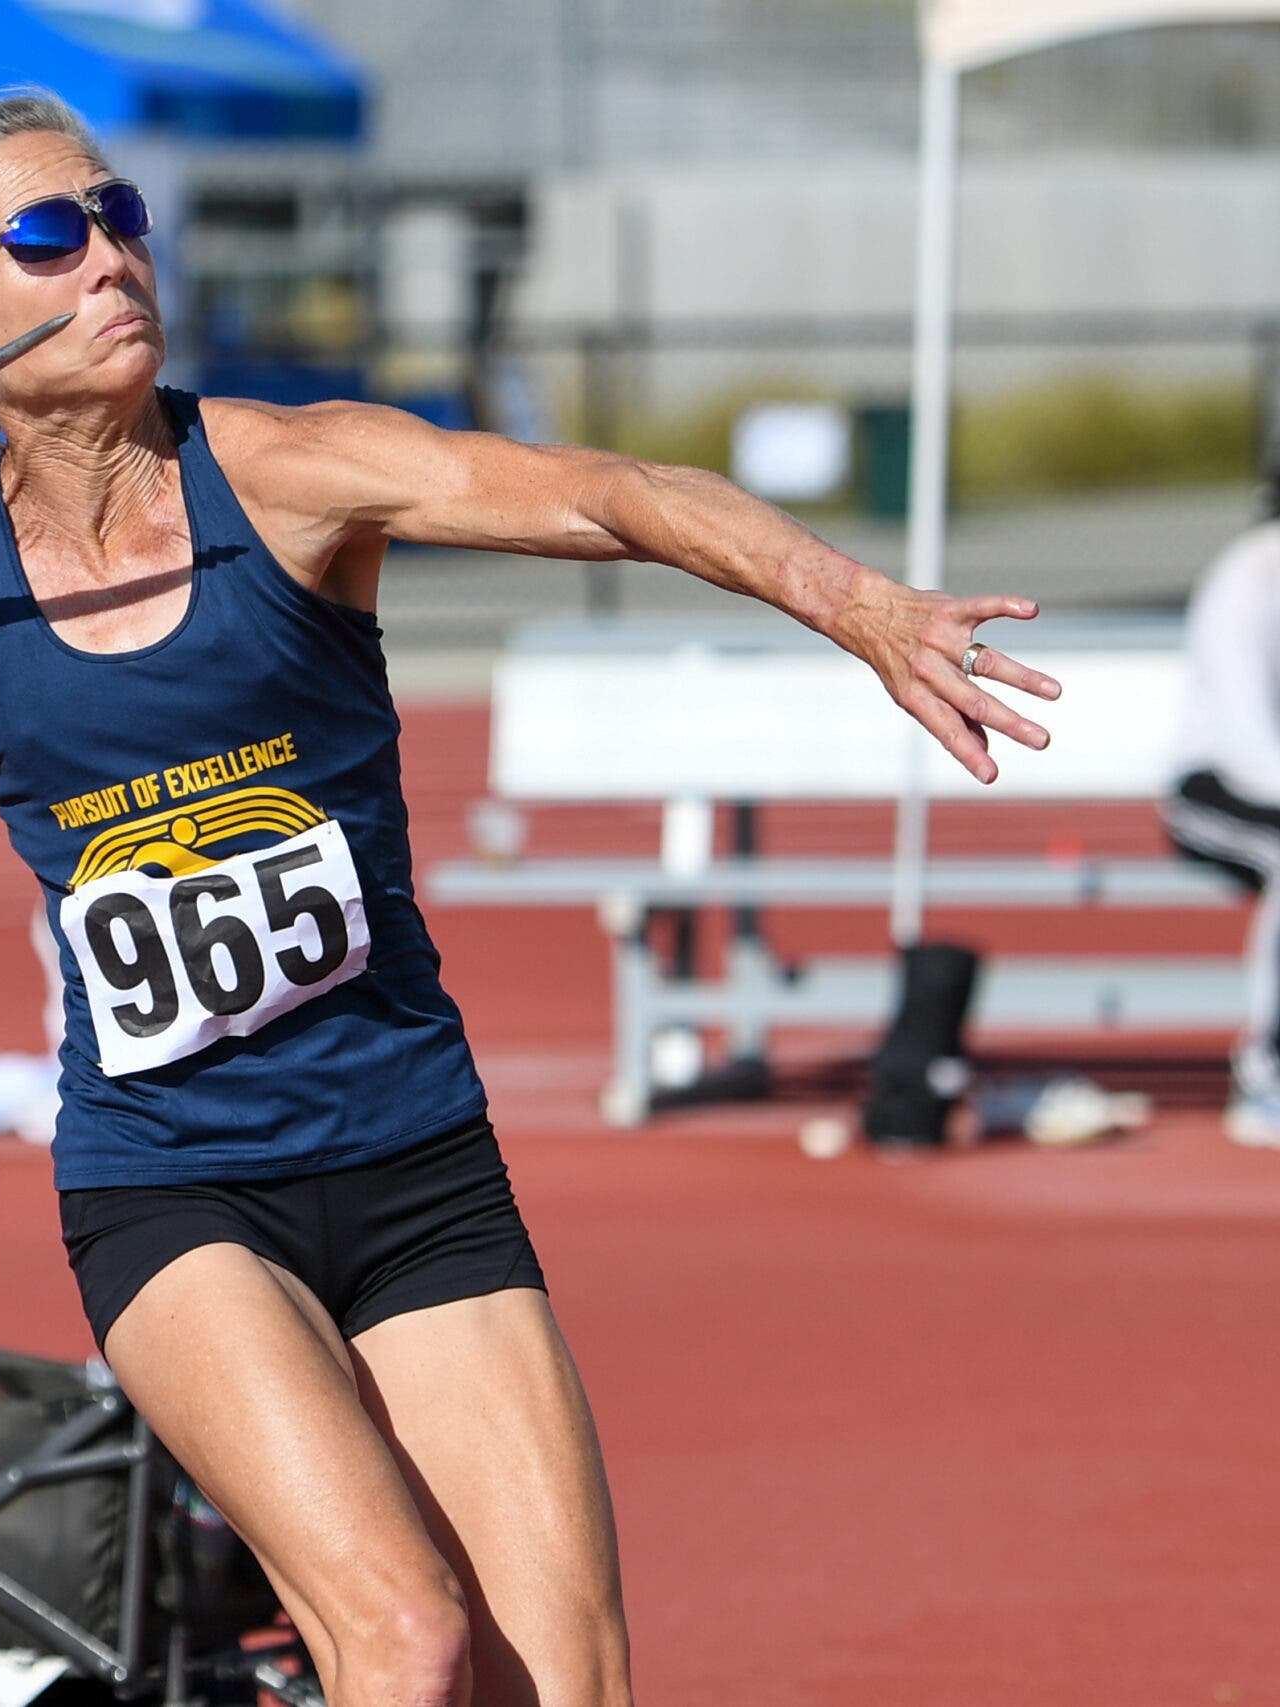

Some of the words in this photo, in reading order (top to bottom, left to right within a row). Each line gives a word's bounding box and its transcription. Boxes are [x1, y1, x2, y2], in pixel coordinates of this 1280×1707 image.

[49, 783, 131, 831] PURSUIT
[131, 773, 161, 809] OF
[163, 732, 298, 799] EXCELLENCE
[84, 844, 349, 1038] 965
